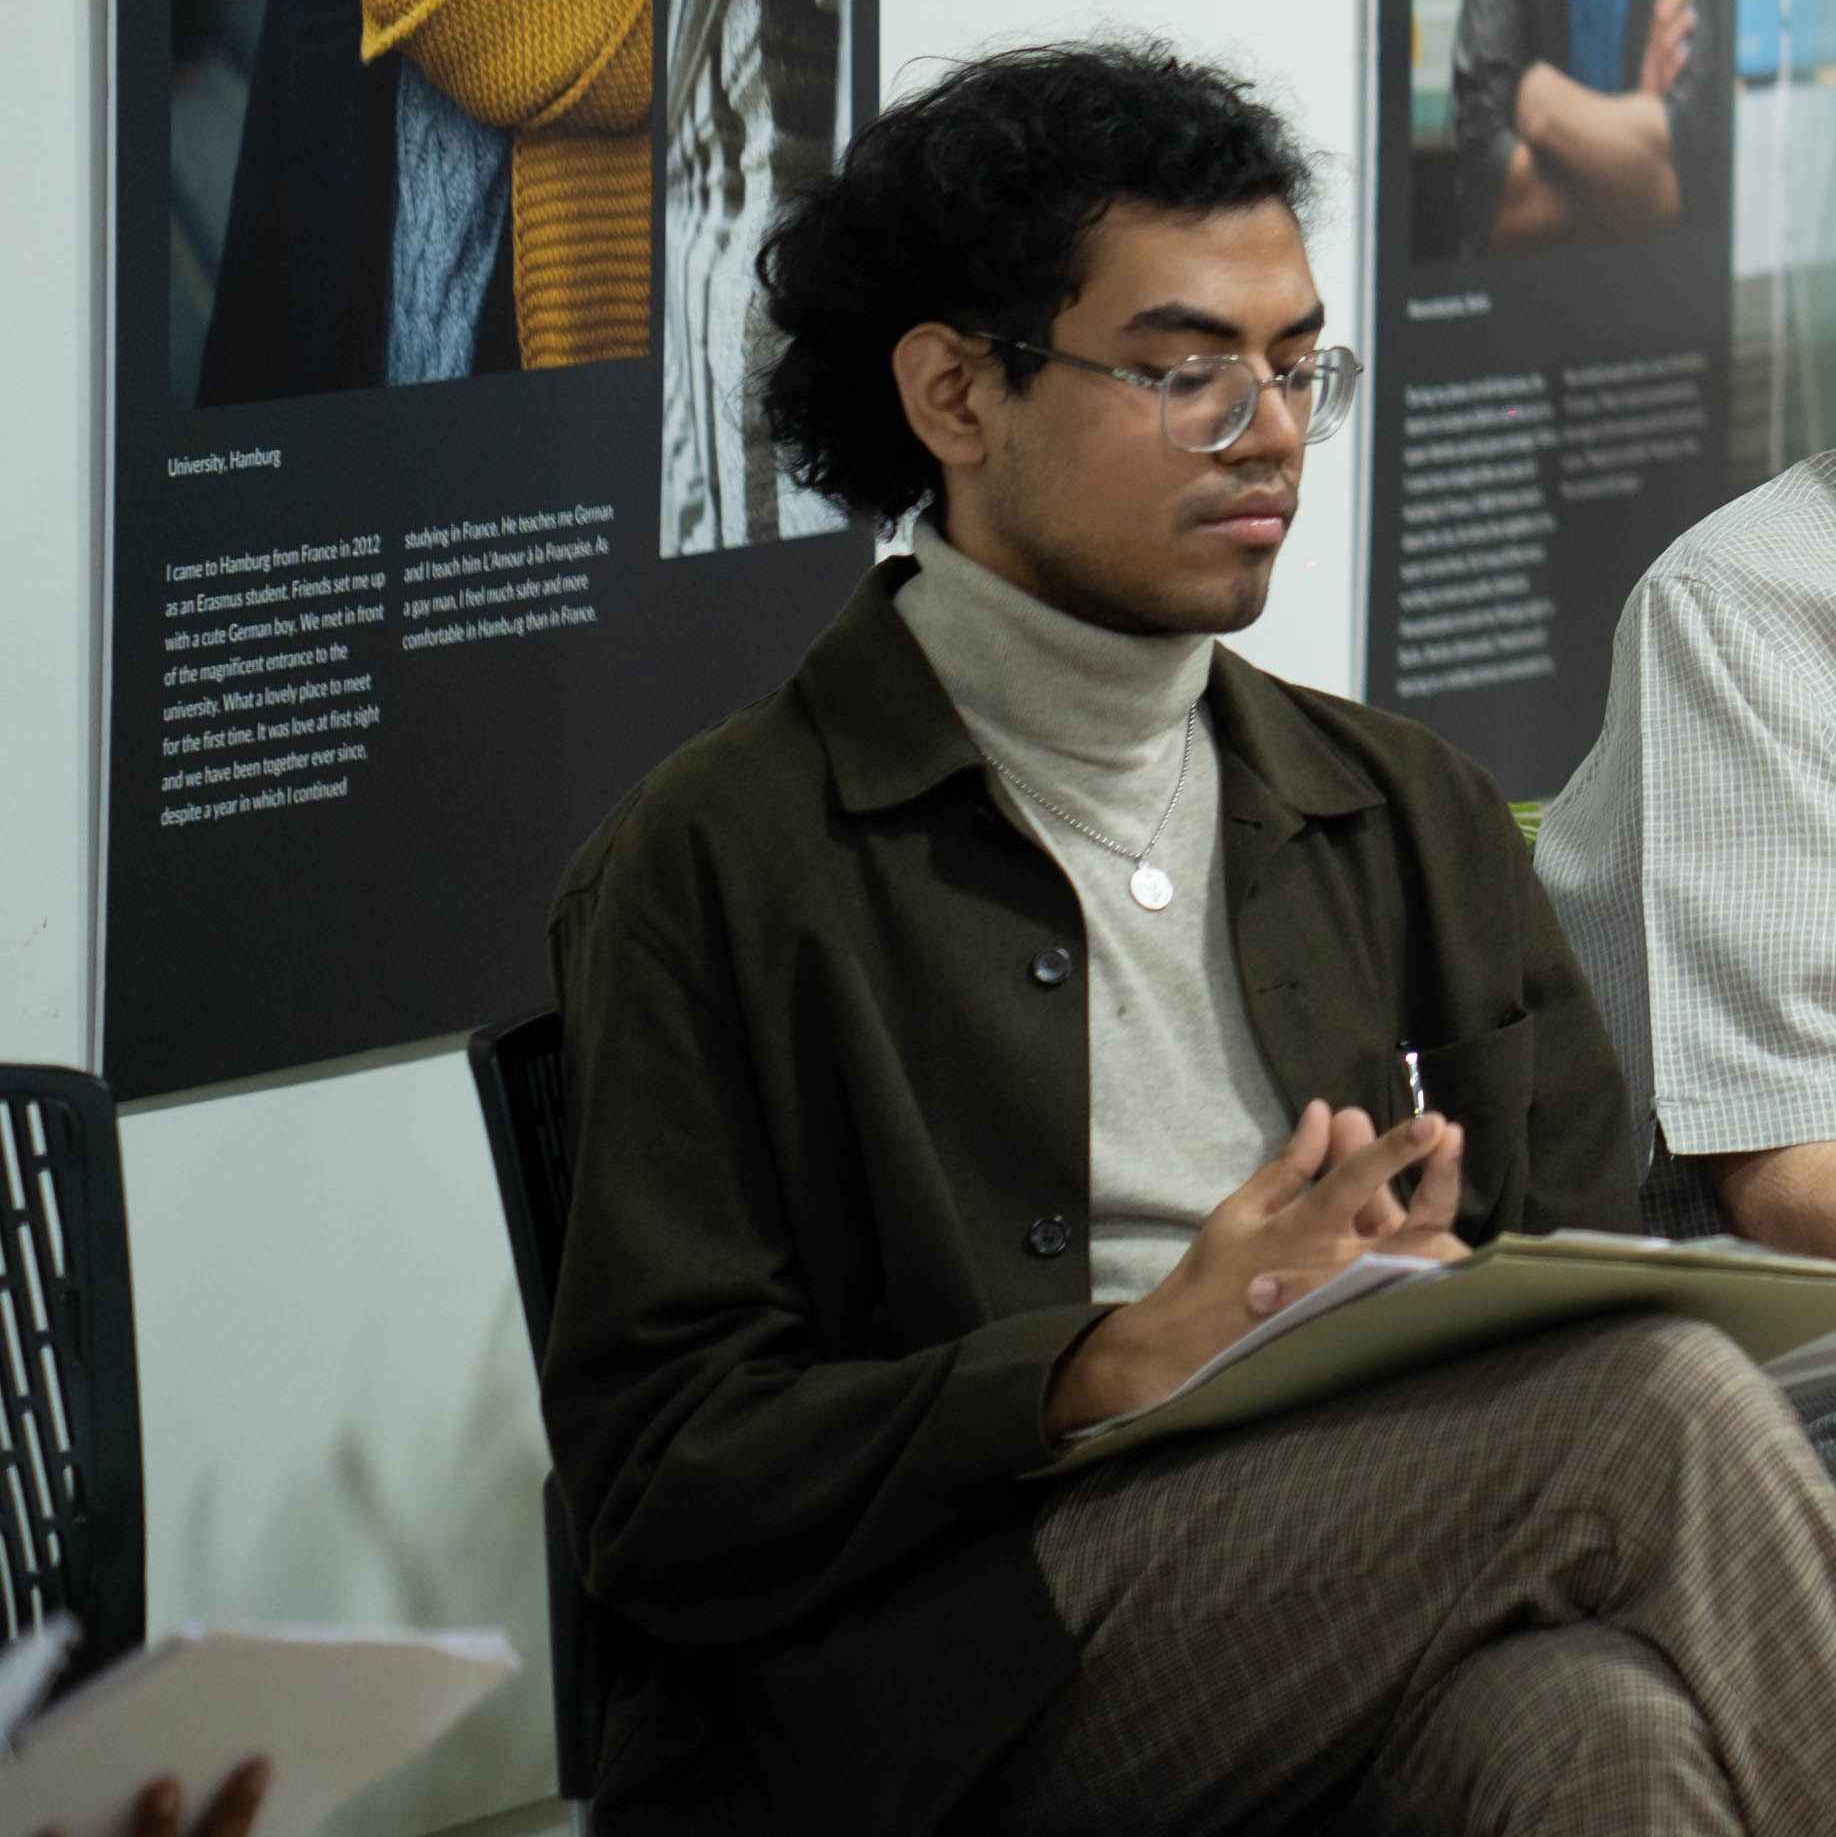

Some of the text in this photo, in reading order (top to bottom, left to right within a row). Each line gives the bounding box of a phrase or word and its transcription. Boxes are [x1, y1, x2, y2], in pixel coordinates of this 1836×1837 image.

[229, 446, 281, 469] Hamburg
[172, 563, 203, 580] came
[205, 557, 217, 576] to
[219, 552, 270, 574] Hamburg
[272, 549, 299, 567] from
[301, 545, 337, 564] France
[339, 540, 350, 559] in
[352, 535, 380, 557] 2012
[165, 601, 178, 616] as
[180, 599, 194, 614] an
[196, 592, 243, 612] Erasmus
[291, 576, 331, 599] Friends
[333, 573, 350, 593] set
[352, 575, 369, 591] me
[370, 573, 385, 593] up
[165, 629, 190, 651] with
[192, 633, 199, 647] a
[201, 625, 226, 646] cute
[228, 622, 272, 642] German
[299, 612, 319, 632] We
[321, 608, 342, 629] met
[344, 607, 355, 626] in
[357, 602, 384, 624] front
[164, 642, 348, 686] of the magnificent entrance to the
[222, 689, 253, 712] What
[255, 692, 262, 707] a
[264, 683, 297, 707] lovely
[299, 680, 327, 706] place
[329, 676, 341, 695] to
[343, 671, 371, 693] meet
[163, 736, 179, 755] for
[181, 732, 200, 752] the
[202, 727, 225, 749] first
[256, 721, 266, 741] It
[268, 722, 289, 739] was
[291, 717, 314, 735] love
[316, 712, 328, 732] at
[330, 708, 351, 730] first
[353, 704, 379, 730] sight
[162, 769, 183, 791] and
[185, 771, 202, 787] we
[204, 765, 231, 784] have
[233, 760, 261, 780] been
[263, 751, 309, 779] together
[311, 750, 335, 767] ever
[161, 802, 201, 828] despite
[203, 804, 211, 819] a
[213, 800, 237, 823] year
[239, 794, 250, 813] in
[252, 787, 285, 811] which
[293, 777, 347, 804] continued
